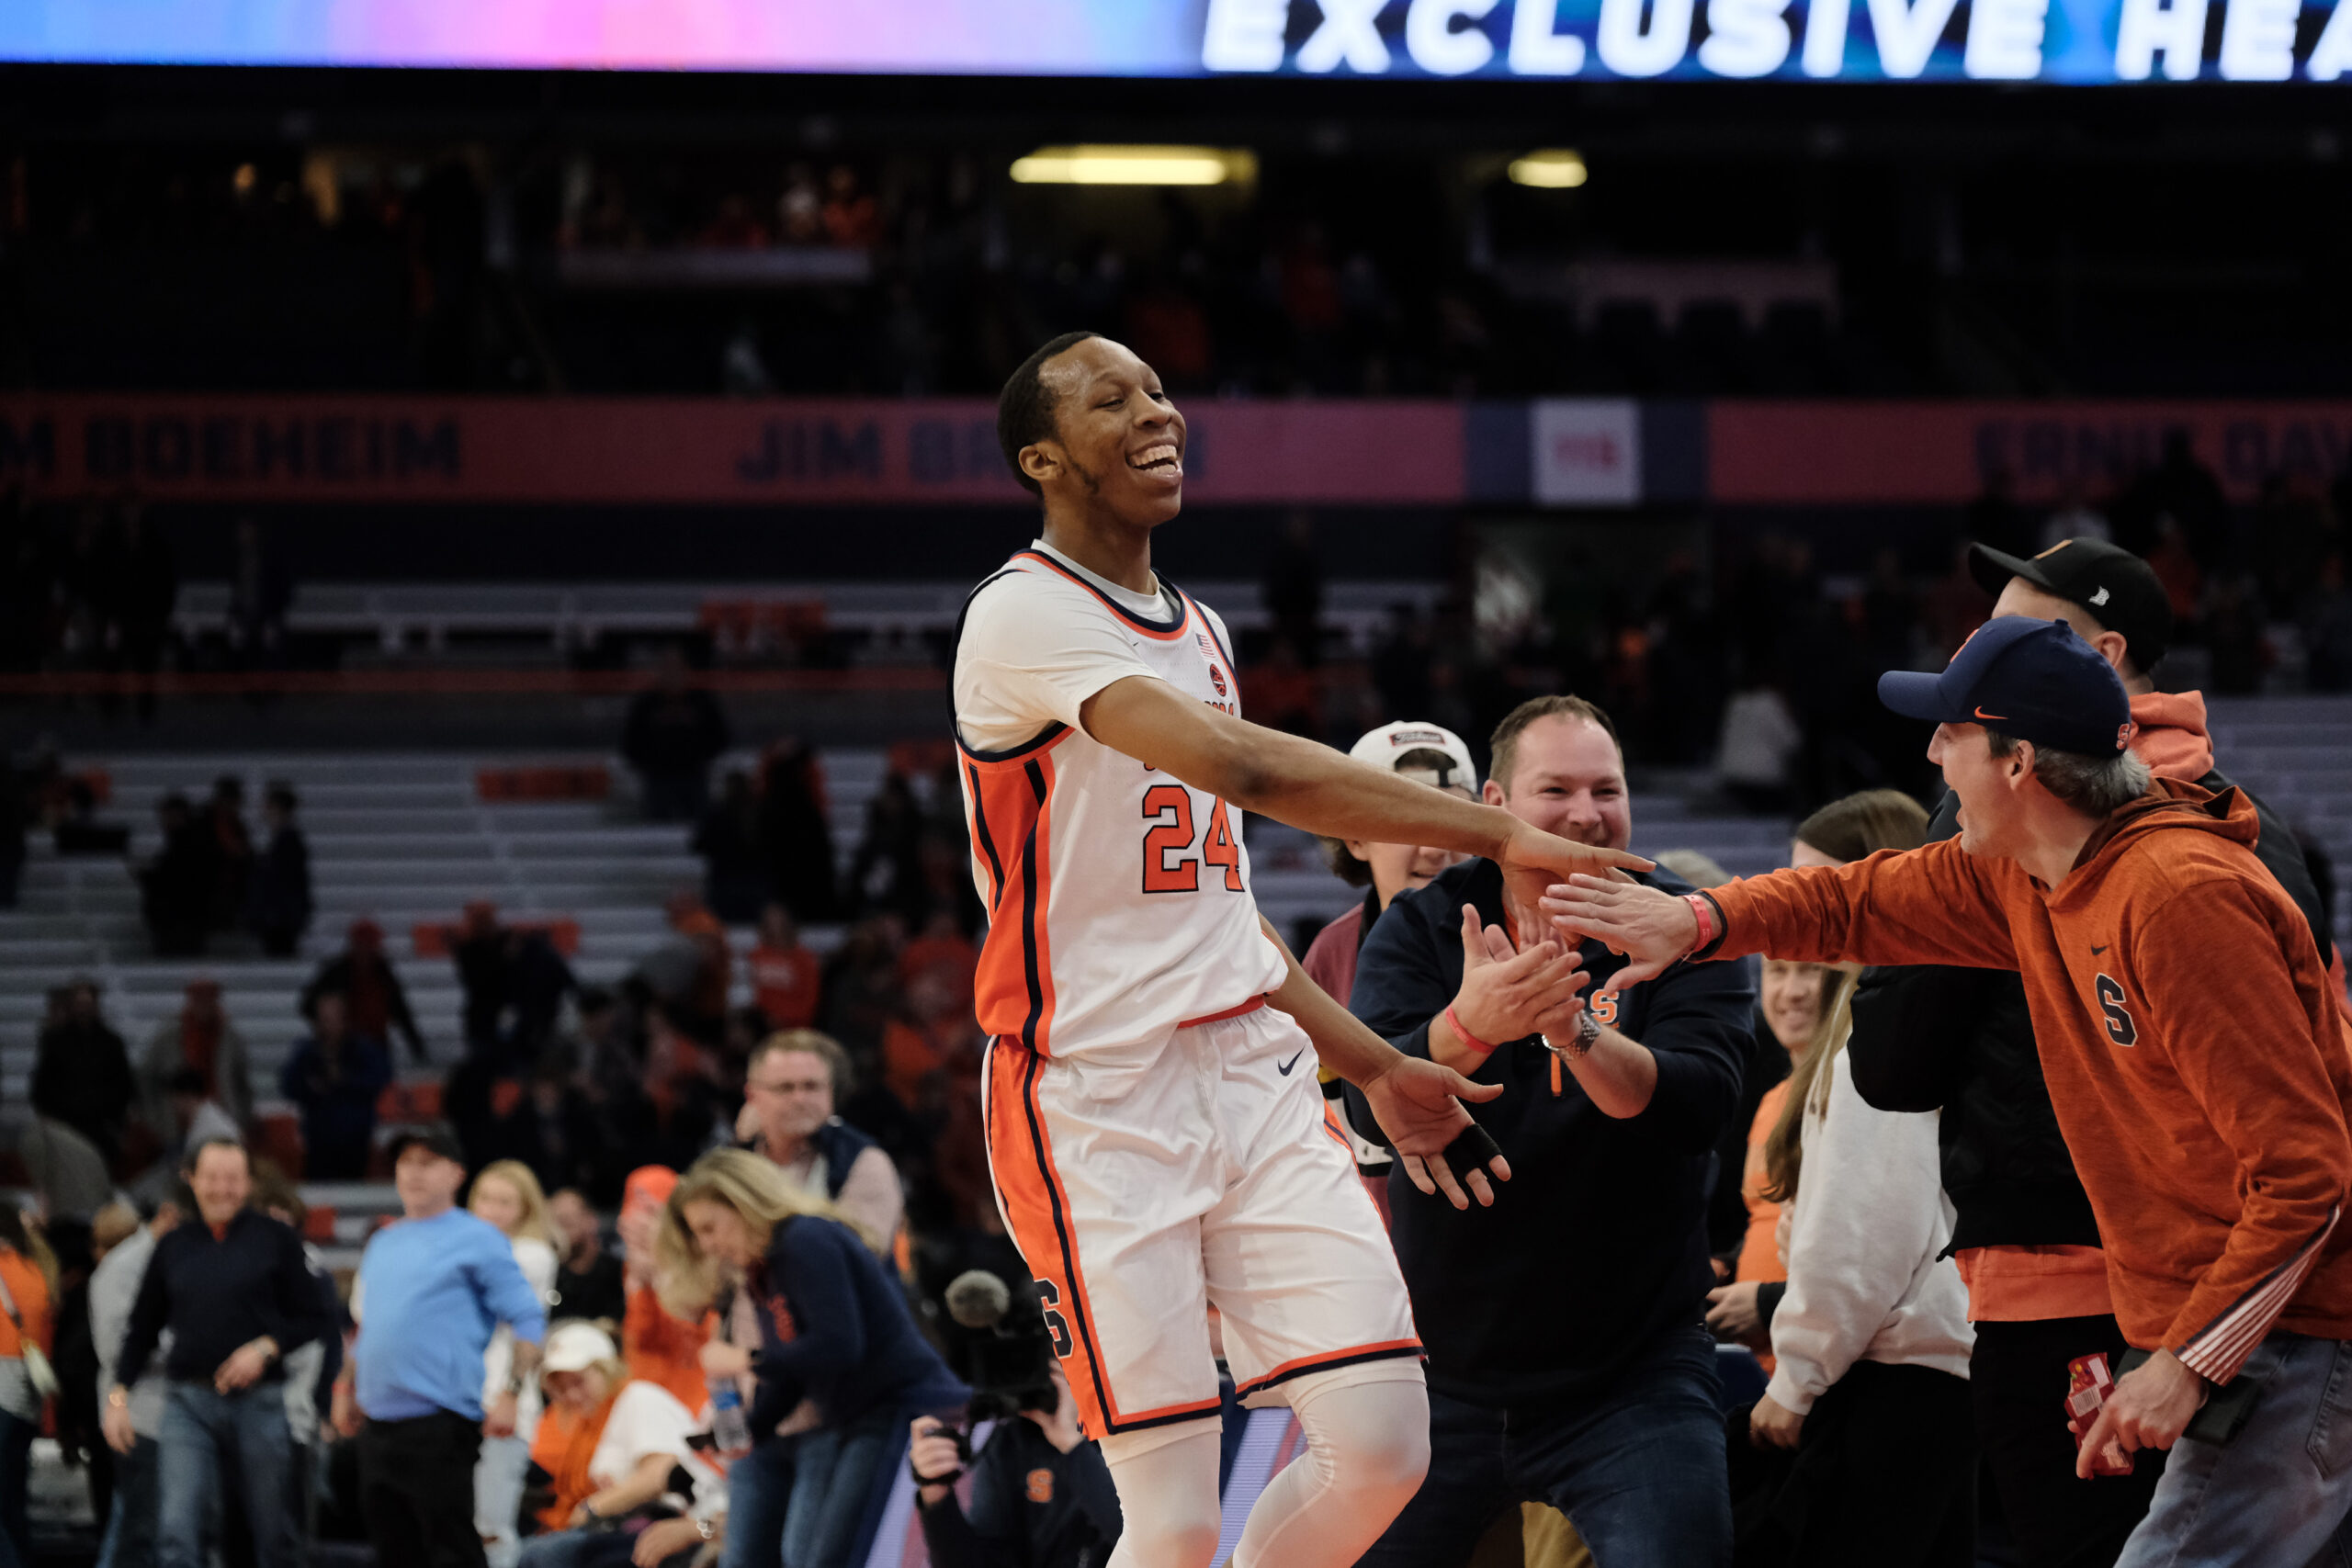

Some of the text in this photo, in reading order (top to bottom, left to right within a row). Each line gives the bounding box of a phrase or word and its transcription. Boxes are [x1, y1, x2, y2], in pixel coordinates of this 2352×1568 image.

[1201, 0, 2045, 80] EXCLUSIVE
[85, 416, 461, 479] BOEHEIM
[736, 418, 884, 482] JIM
[2116, 723, 2131, 750] S
[1142, 784, 1245, 894] 24
[1589, 988, 1620, 1024] S
[2095, 972, 2139, 1047] S
[1035, 1277, 1074, 1359] S
[1025, 1467, 1055, 1504] S
